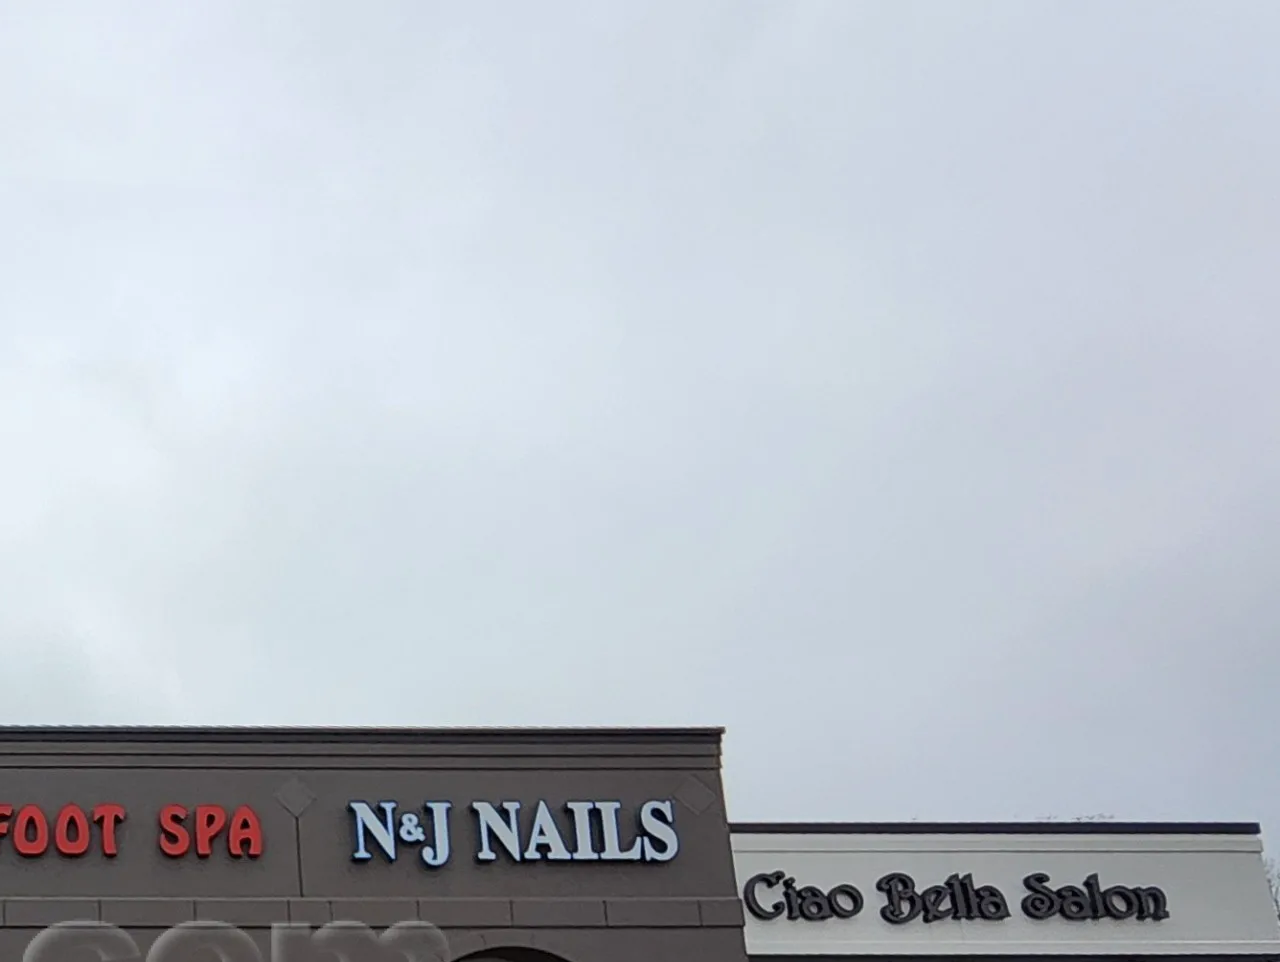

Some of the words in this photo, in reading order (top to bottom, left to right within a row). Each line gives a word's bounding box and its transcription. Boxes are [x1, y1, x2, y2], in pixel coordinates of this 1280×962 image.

[158, 804, 263, 857] SPA
[350, 800, 453, 868] N&J
[472, 800, 680, 863] NAILS
[743, 870, 864, 922] Ciao
[876, 872, 1011, 924] Bella
[1021, 872, 1169, 922] Salon
